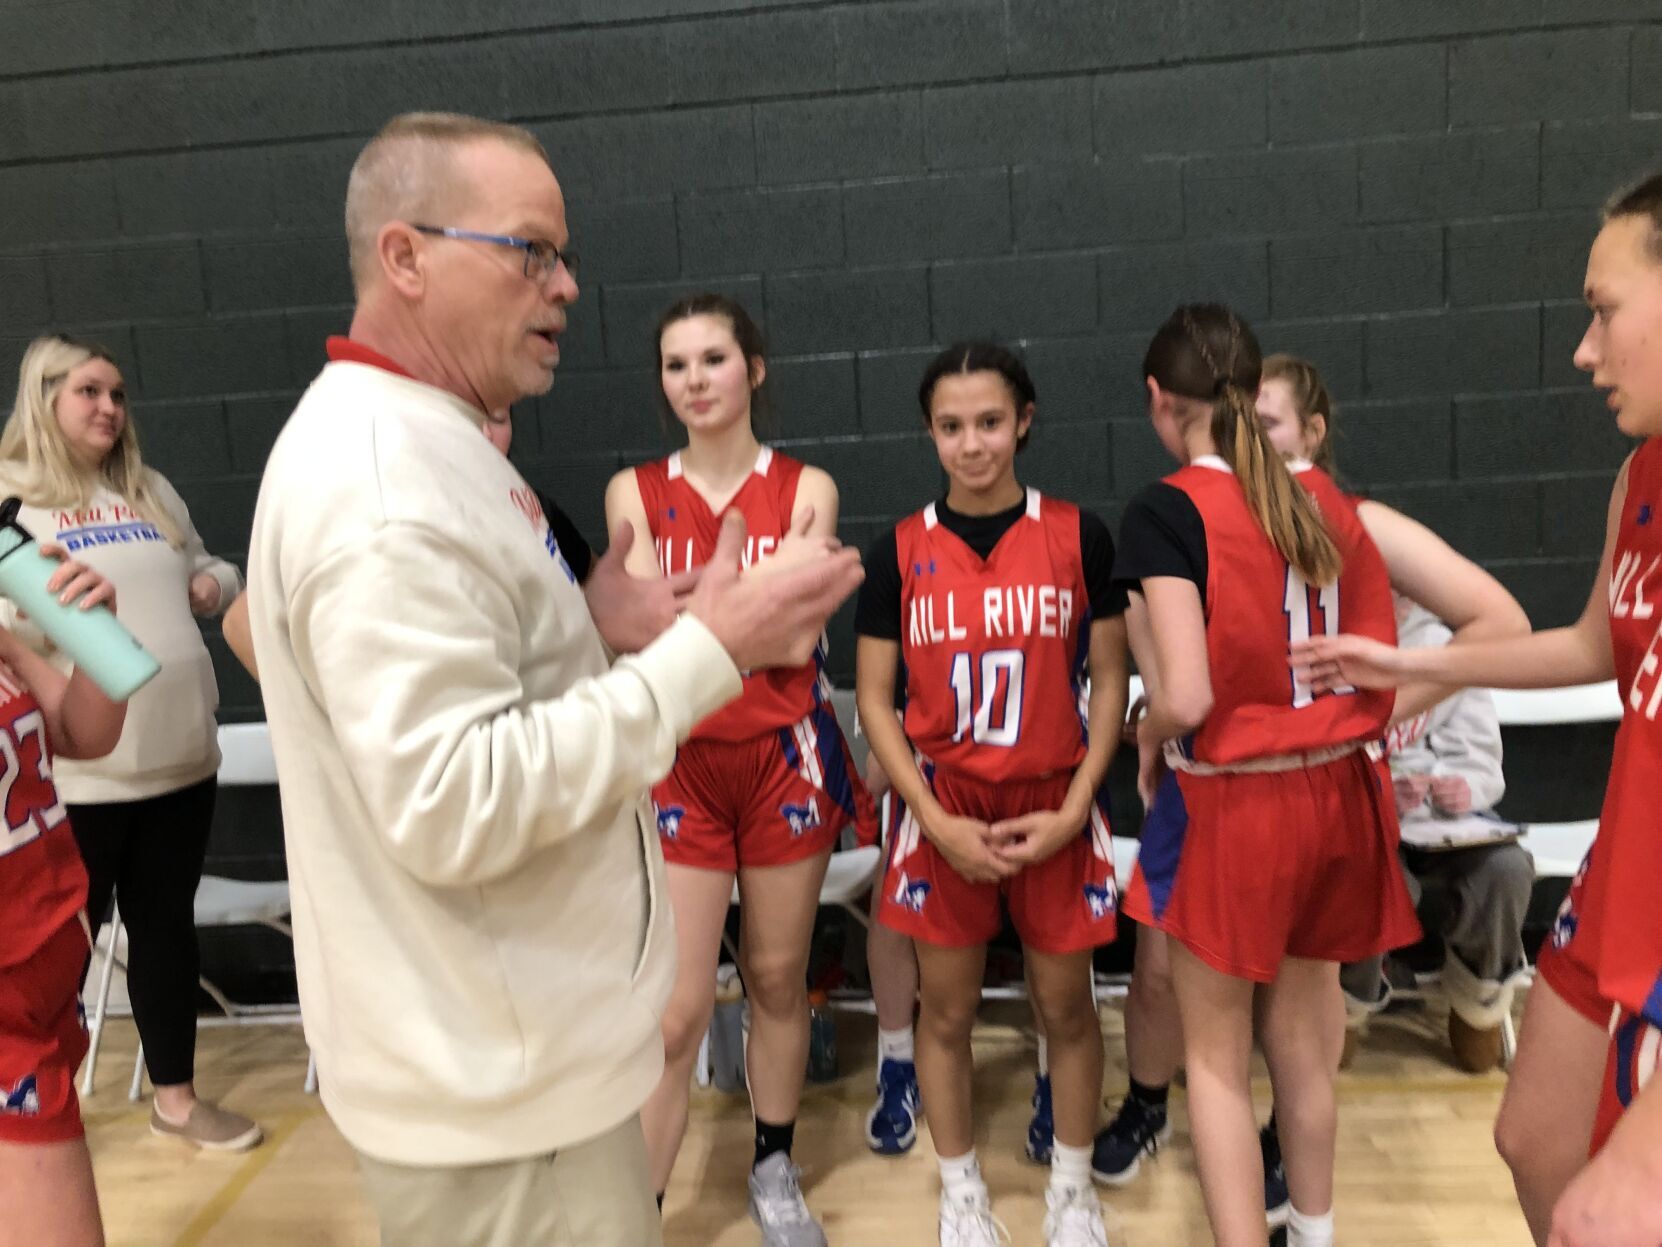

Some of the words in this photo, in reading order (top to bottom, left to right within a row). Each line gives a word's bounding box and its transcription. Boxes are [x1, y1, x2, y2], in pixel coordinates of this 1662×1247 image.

[65, 527, 168, 552] BASKETBA
[983, 583, 1073, 639] RIVER
[1283, 559, 1356, 709] 11
[949, 648, 1025, 747] 10
[0, 709, 67, 856] 23
